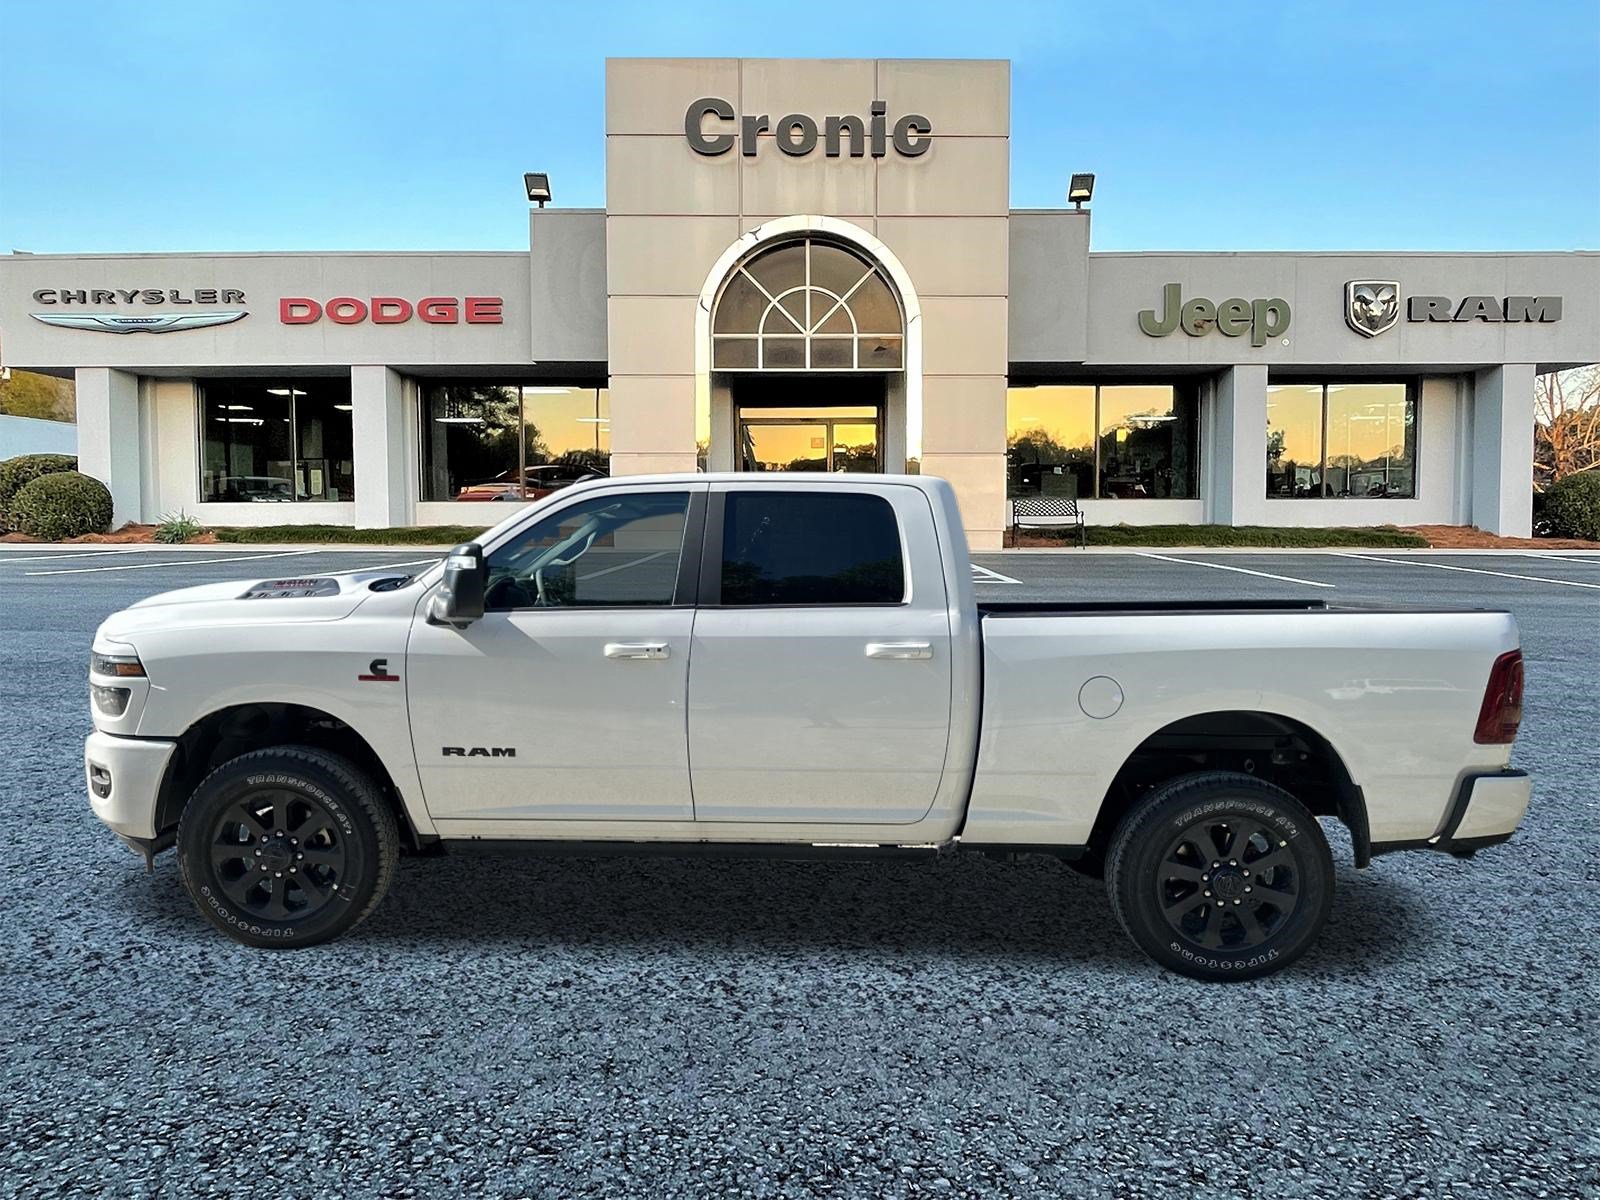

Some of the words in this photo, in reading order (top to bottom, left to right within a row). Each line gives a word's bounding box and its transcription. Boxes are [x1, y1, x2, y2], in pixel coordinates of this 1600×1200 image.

[685, 98, 932, 157] Cronic
[32, 288, 247, 305] CHRYSLER
[1406, 296, 1563, 322] RAM
[279, 296, 504, 325] DODGE
[1138, 283, 1291, 347] Jeep
[442, 746, 517, 757] RAM
[247, 774, 339, 810] TRANSFORCE
[1175, 801, 1275, 826] TRANSFORCE
